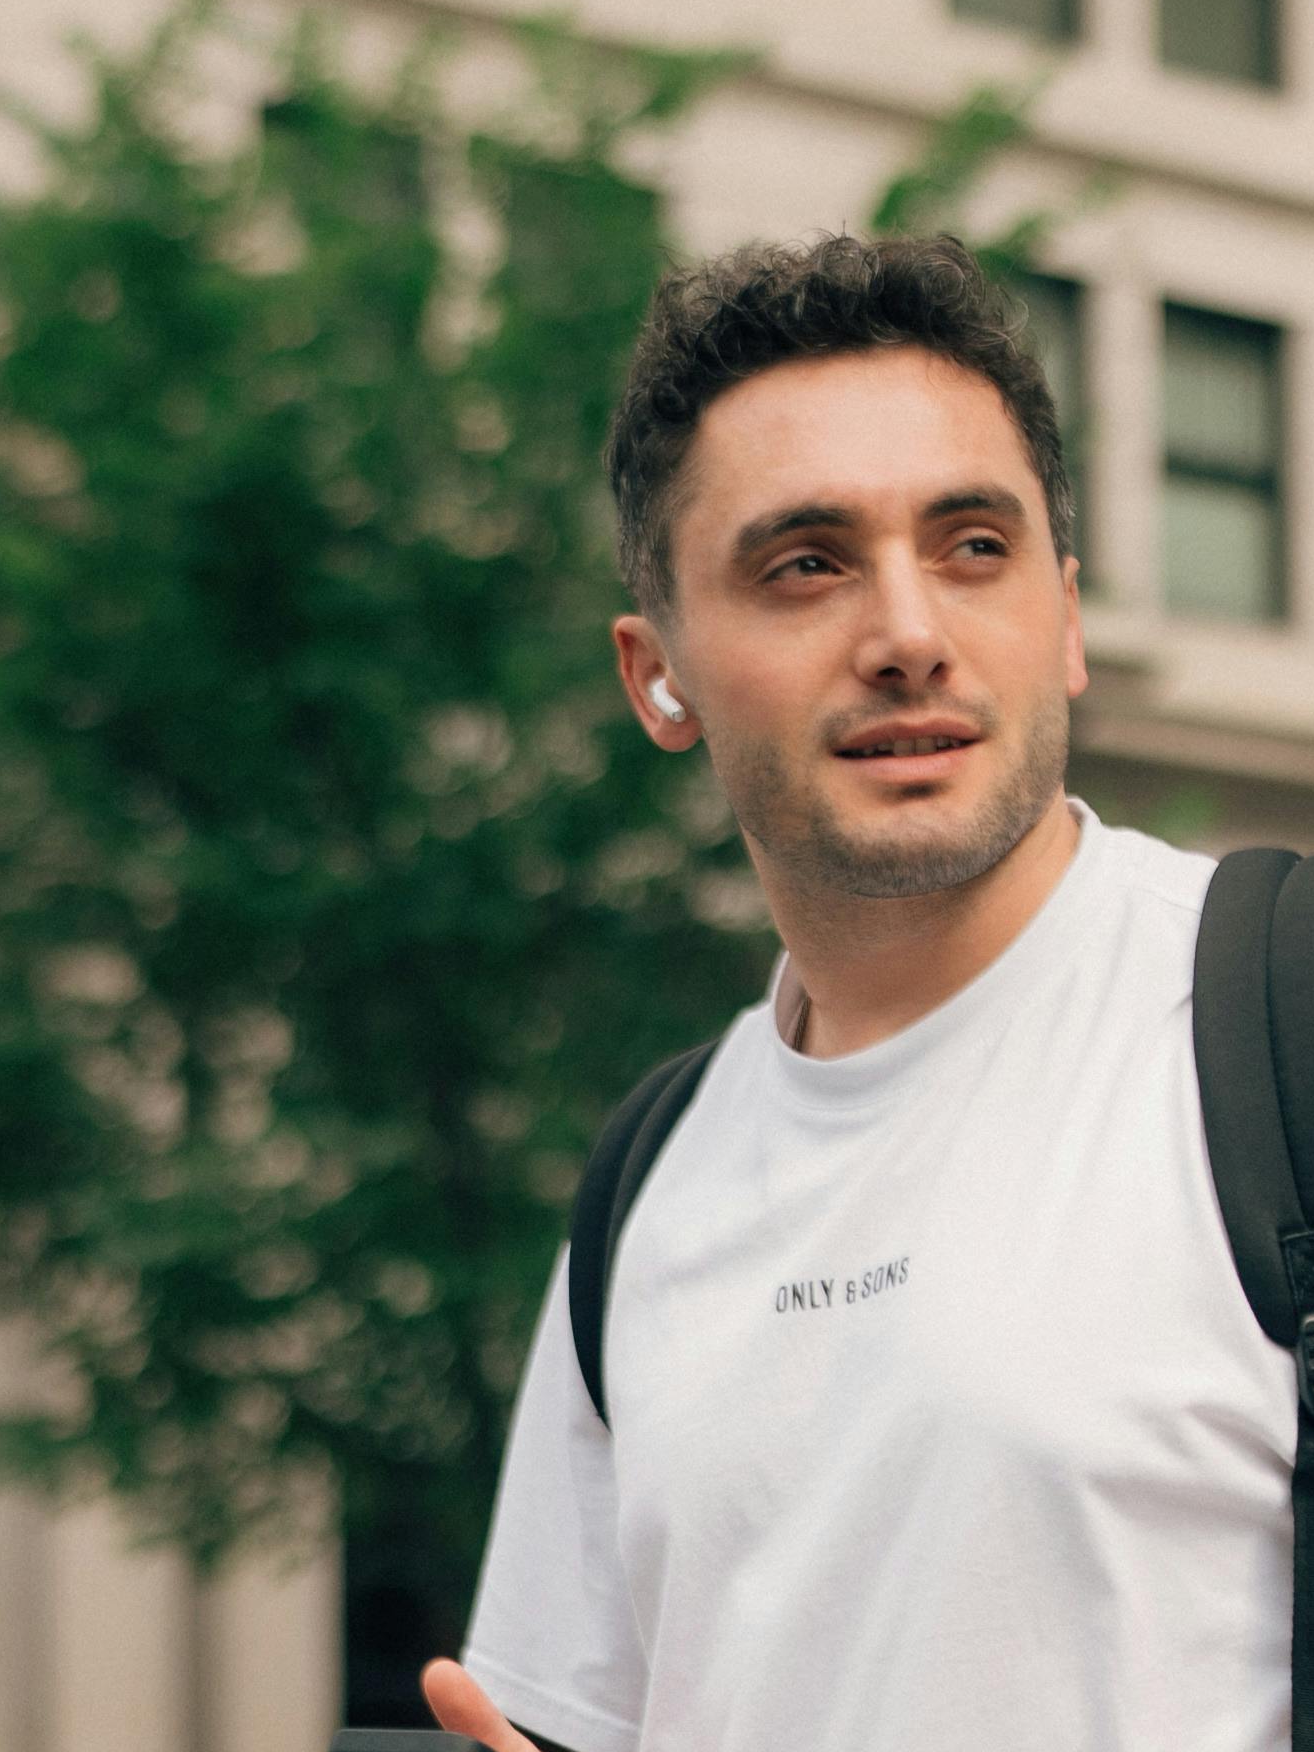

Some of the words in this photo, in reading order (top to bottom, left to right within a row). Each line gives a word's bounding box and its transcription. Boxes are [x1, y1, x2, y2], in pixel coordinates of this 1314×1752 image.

[775, 1279, 834, 1313] ONLY
[845, 1280, 856, 1304] &
[861, 1256, 910, 1299] SONS
